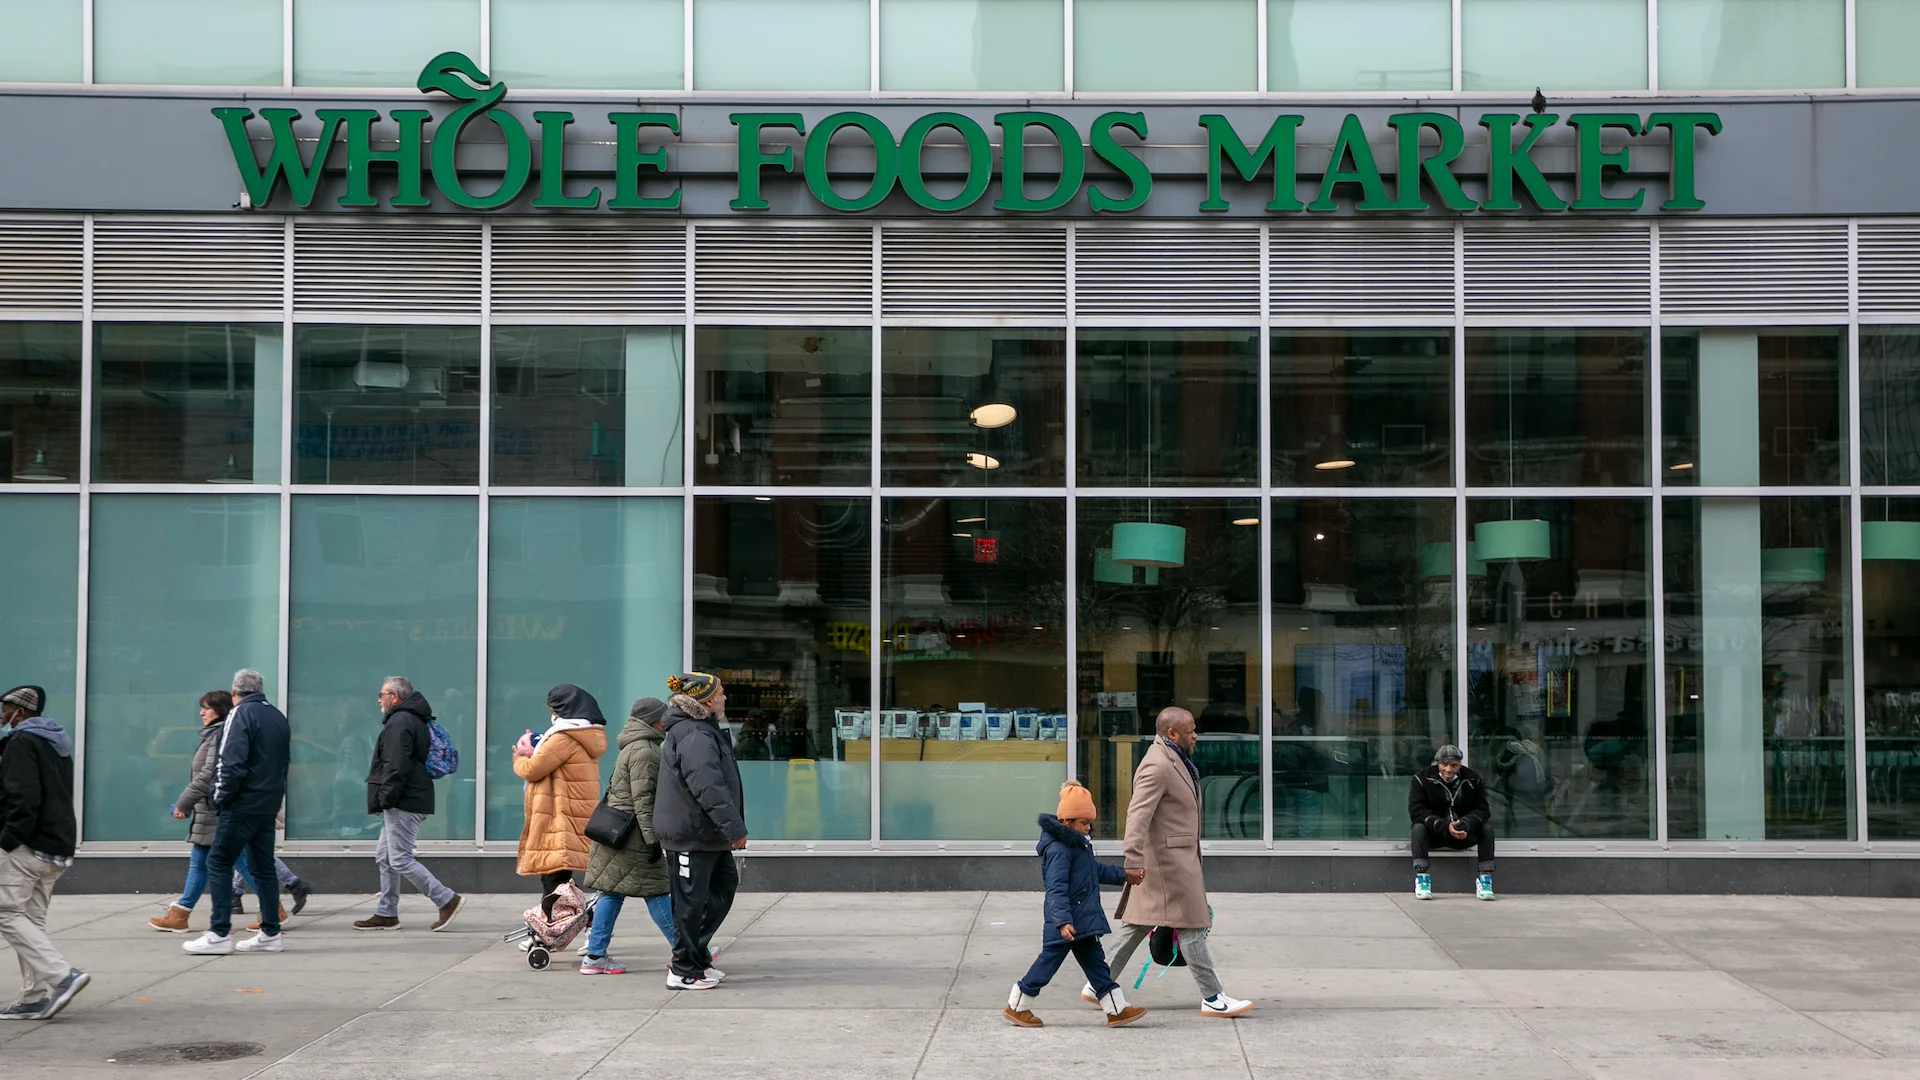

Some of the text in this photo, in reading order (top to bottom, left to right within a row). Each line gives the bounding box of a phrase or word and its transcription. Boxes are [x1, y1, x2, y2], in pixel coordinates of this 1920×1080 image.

[211, 53, 1723, 212] WHOLE FOODS MARKET
